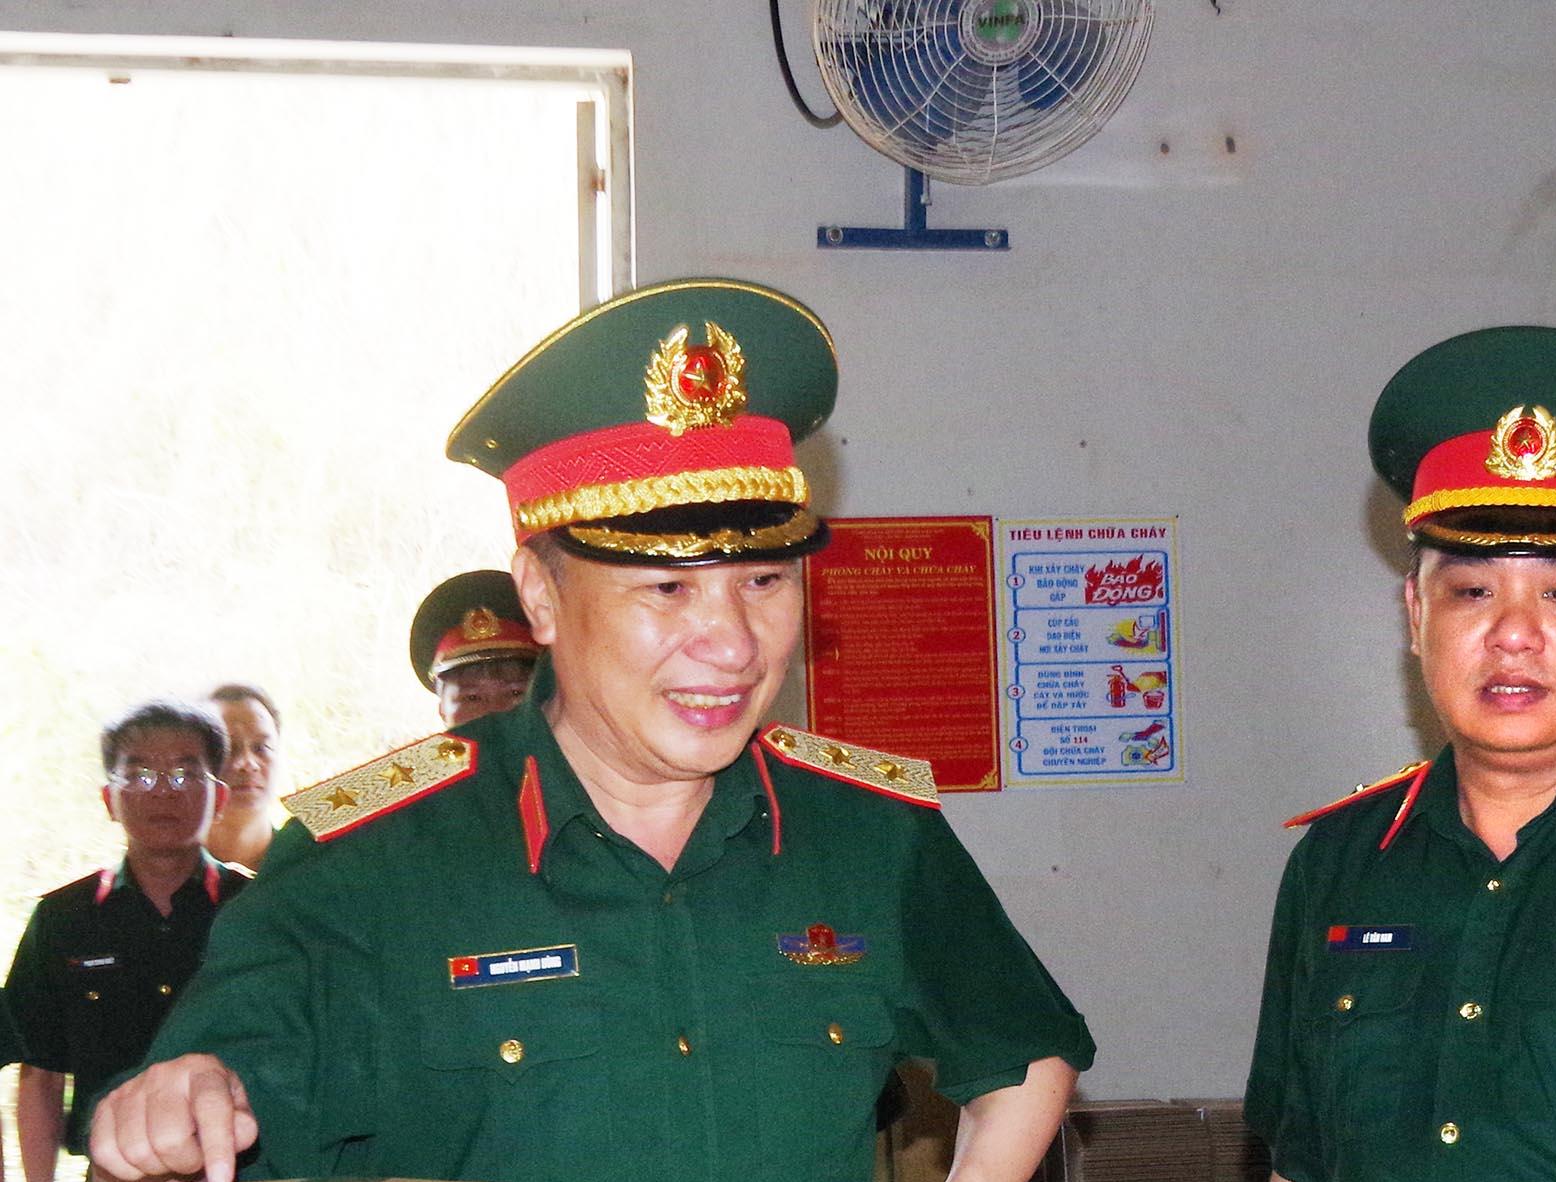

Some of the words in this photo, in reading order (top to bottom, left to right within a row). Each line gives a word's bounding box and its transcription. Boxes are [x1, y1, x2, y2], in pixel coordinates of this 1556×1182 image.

[1009, 528, 1042, 541] TIÊU
[1047, 527, 1083, 542] LỆNH
[1088, 523, 1126, 540] CHỮA
[1131, 526, 1166, 539] CHÁY
[864, 545, 895, 564] NỘI
[898, 547, 933, 562] QUY
[1013, 577, 1019, 586] 1
[1092, 584, 1153, 606] ĐỘNG
[1013, 631, 1020, 640] 2
[1012, 687, 1019, 696] 3
[1015, 740, 1023, 748] 4
[1074, 736, 1088, 744] 114
